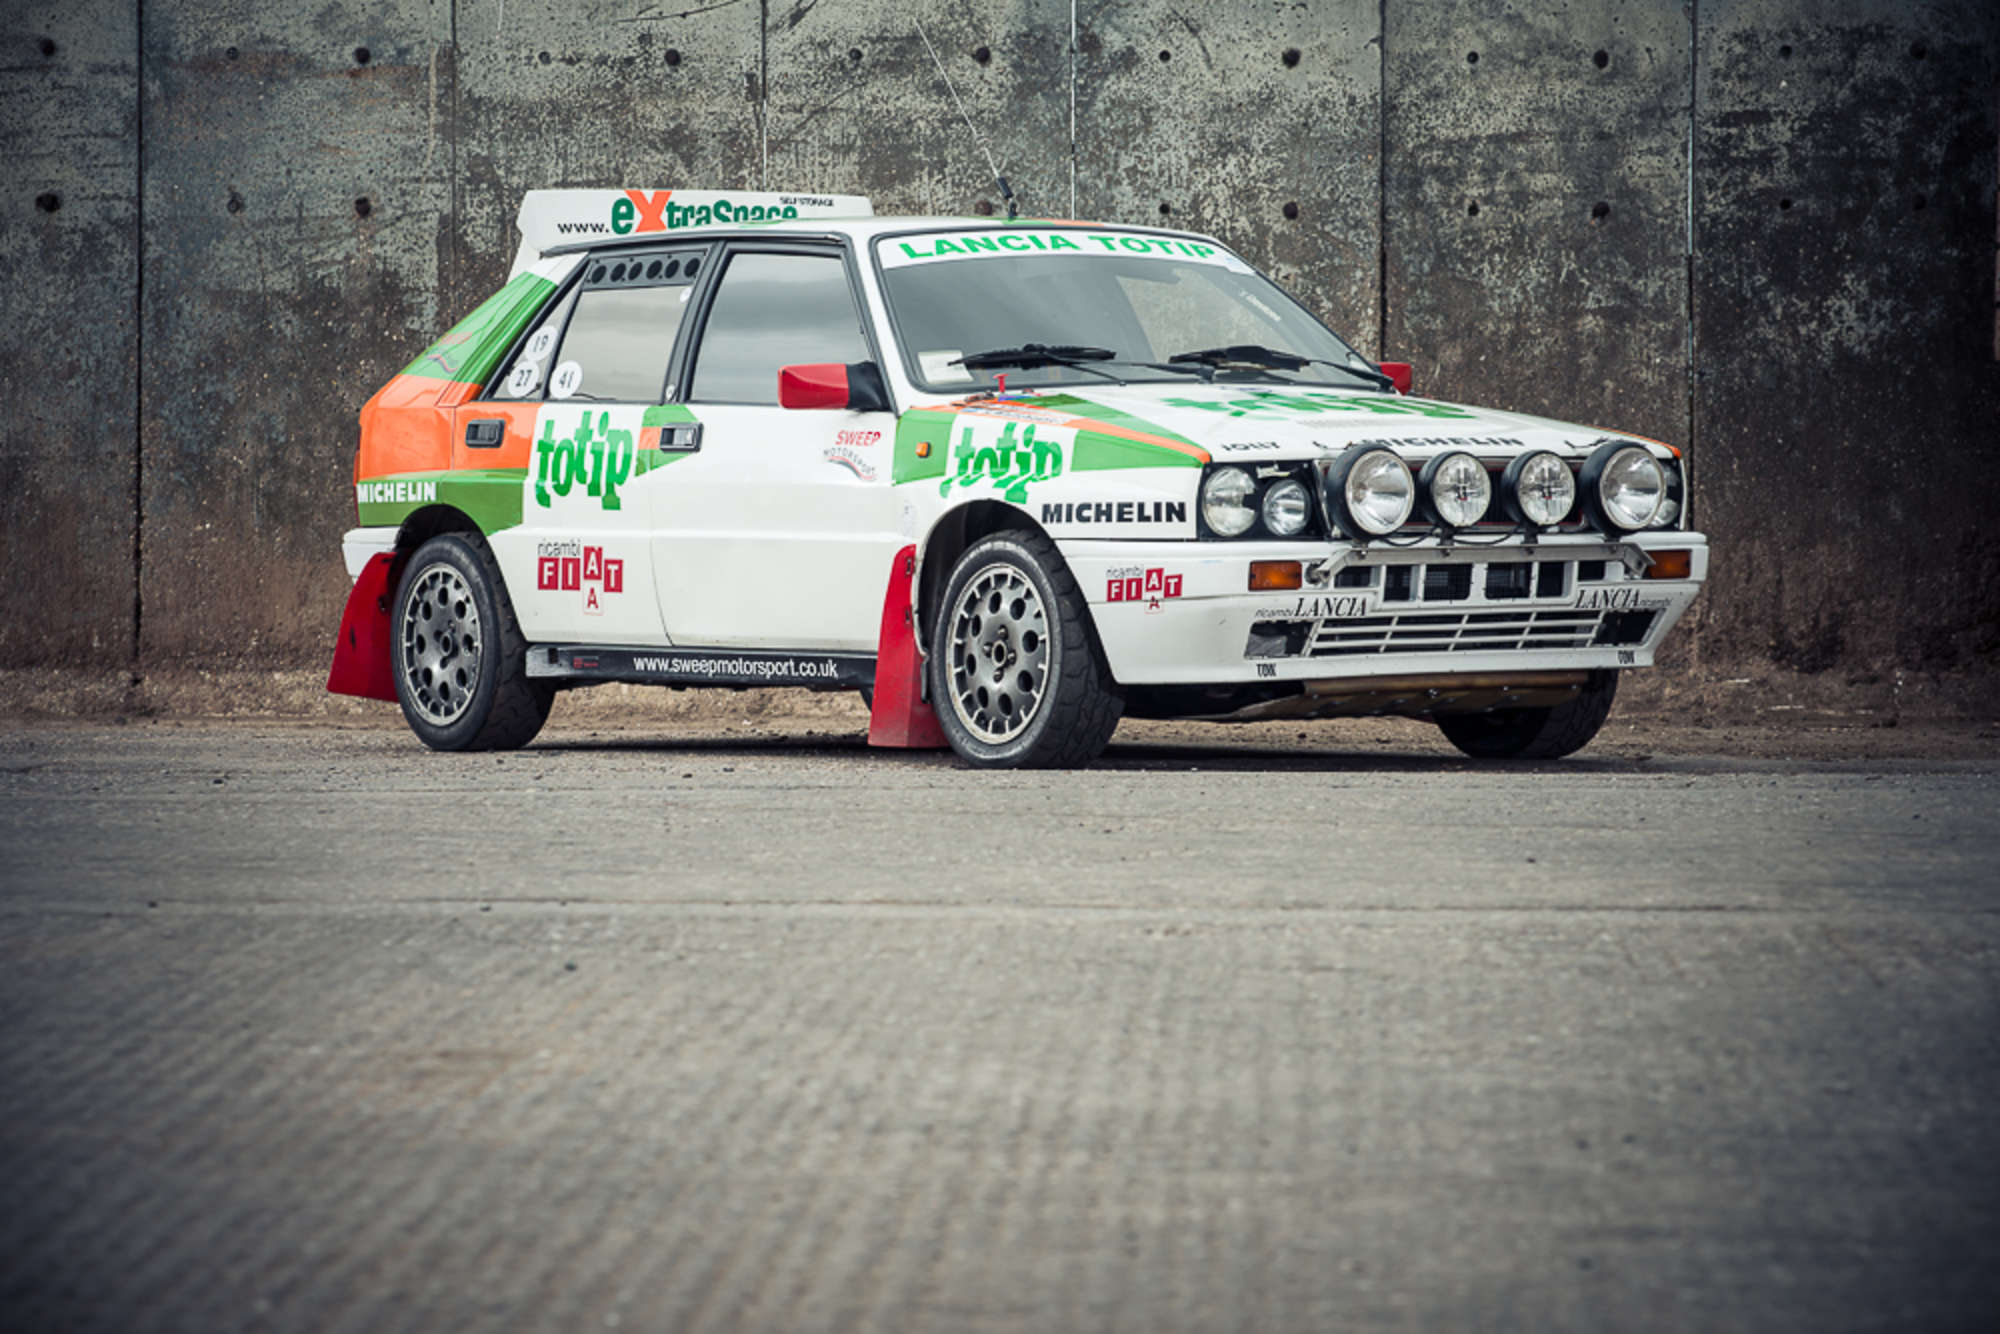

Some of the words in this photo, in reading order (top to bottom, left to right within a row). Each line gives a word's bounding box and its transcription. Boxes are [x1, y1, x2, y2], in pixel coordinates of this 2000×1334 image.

[900, 234, 1081, 259] LANCIA
[1088, 235, 1216, 259] TOTIP
[533, 334, 549, 353] 19
[514, 369, 533, 388] 27
[558, 368, 575, 389] 41
[835, 430, 881, 447] SWEEP
[535, 409, 634, 511] totip
[939, 421, 1063, 505] totip
[357, 481, 438, 504] MICHELIN
[1041, 502, 1187, 524] MICHELIN
[537, 538, 581, 557] ricambi
[539, 548, 622, 591] FIAT
[1106, 565, 1144, 578] ricambi
[1109, 569, 1182, 600] FIAT
[1294, 597, 1368, 617] LANCIA
[1574, 588, 1640, 609] LANCIA
[633, 656, 838, 679] www.sweepmotorsport.co.uk
